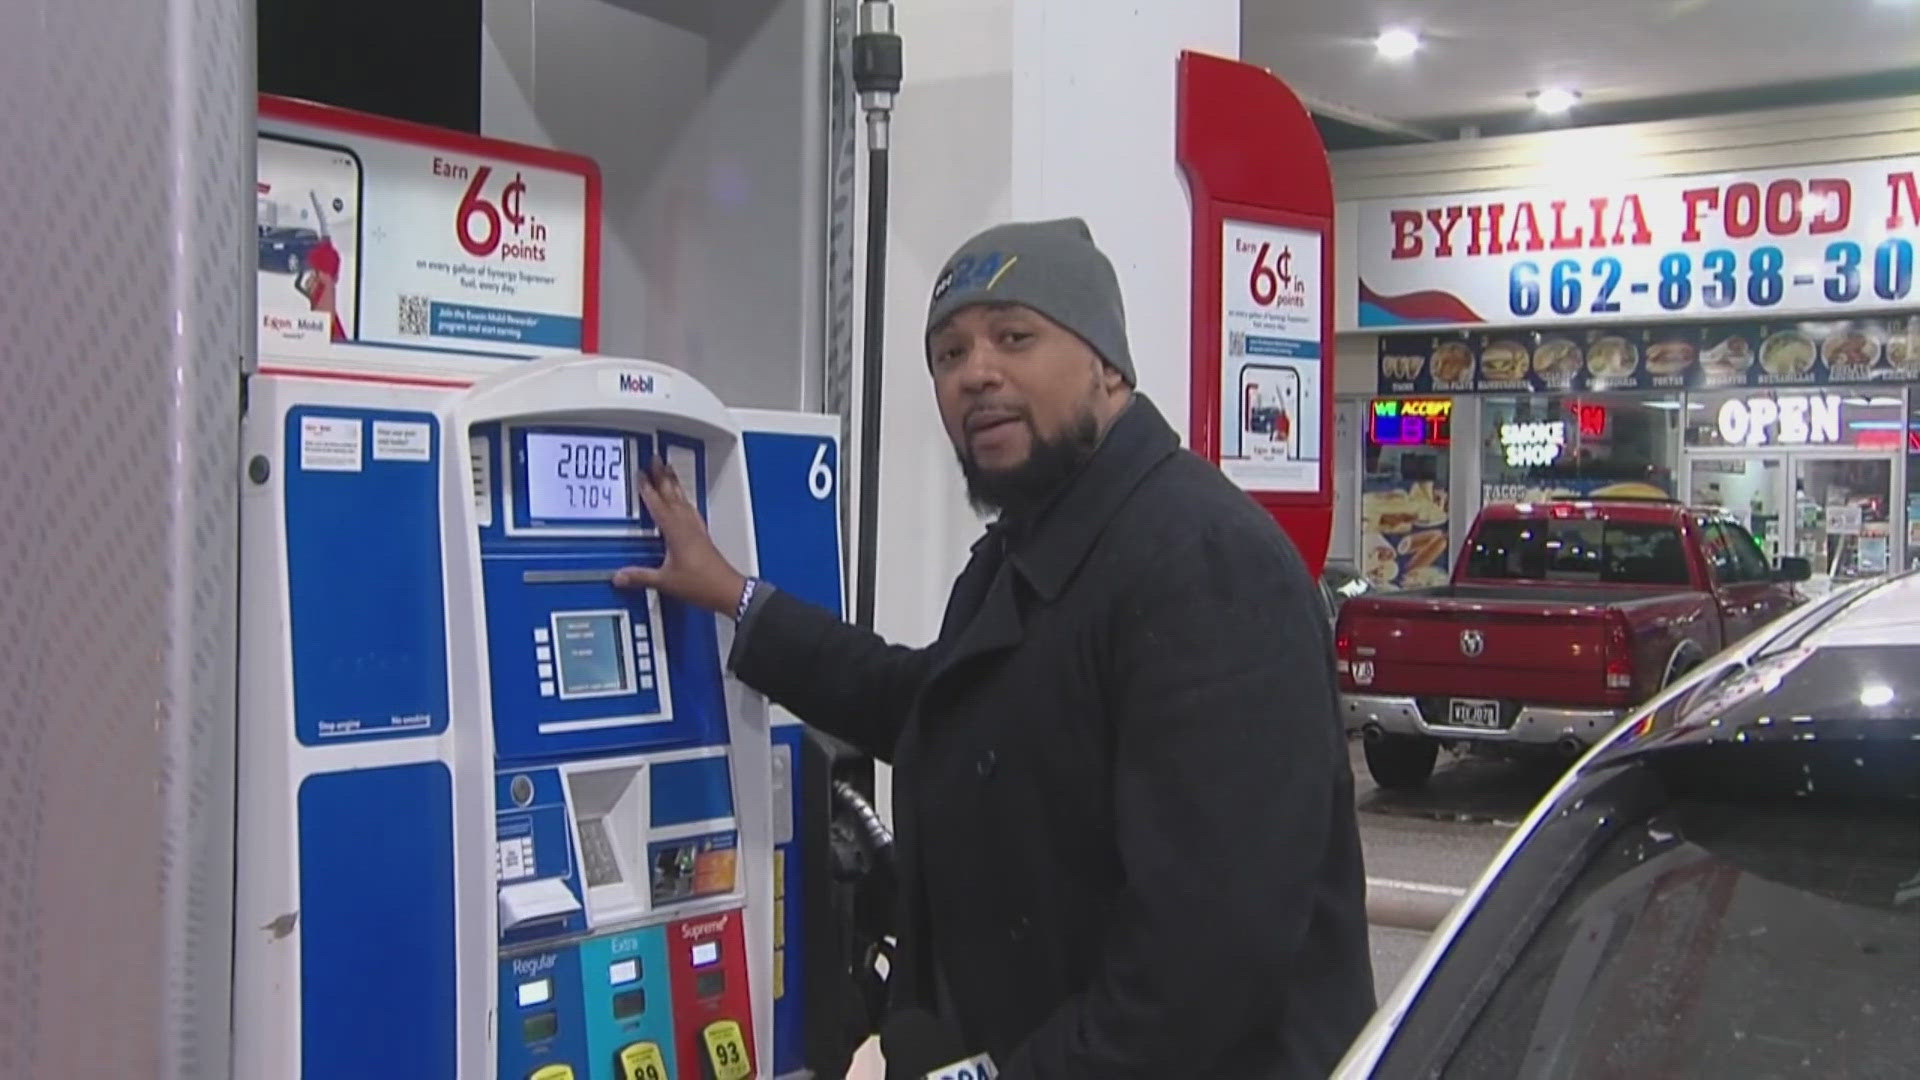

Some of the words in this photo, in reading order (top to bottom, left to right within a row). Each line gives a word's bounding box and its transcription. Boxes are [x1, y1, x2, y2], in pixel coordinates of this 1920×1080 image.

[433, 157, 468, 180] Earn
[530, 215, 546, 242] in
[1390, 193, 1653, 260] BYHALIA
[1681, 178, 1852, 243] FOOD
[501, 239, 545, 261] points
[1235, 238, 1257, 253] Earn
[428, 261, 450, 273] every
[478, 282, 500, 294] every
[1294, 275, 1305, 293] in
[1276, 294, 1305, 309] points
[619, 374, 654, 393] Mobil
[1374, 400, 1397, 416] WE
[1401, 400, 1452, 416] ACCEPT
[1718, 394, 1842, 446] OPEN
[1500, 421, 1564, 445] SMOKE
[1506, 444, 1559, 467] SHOP
[809, 443, 833, 500] 6
[1483, 484, 1525, 500] TACOS
[611, 938, 638, 954] Extra
[512, 953, 558, 977] Regular
[716, 1041, 740, 1067] 93
[634, 1063, 659, 1080] 89
